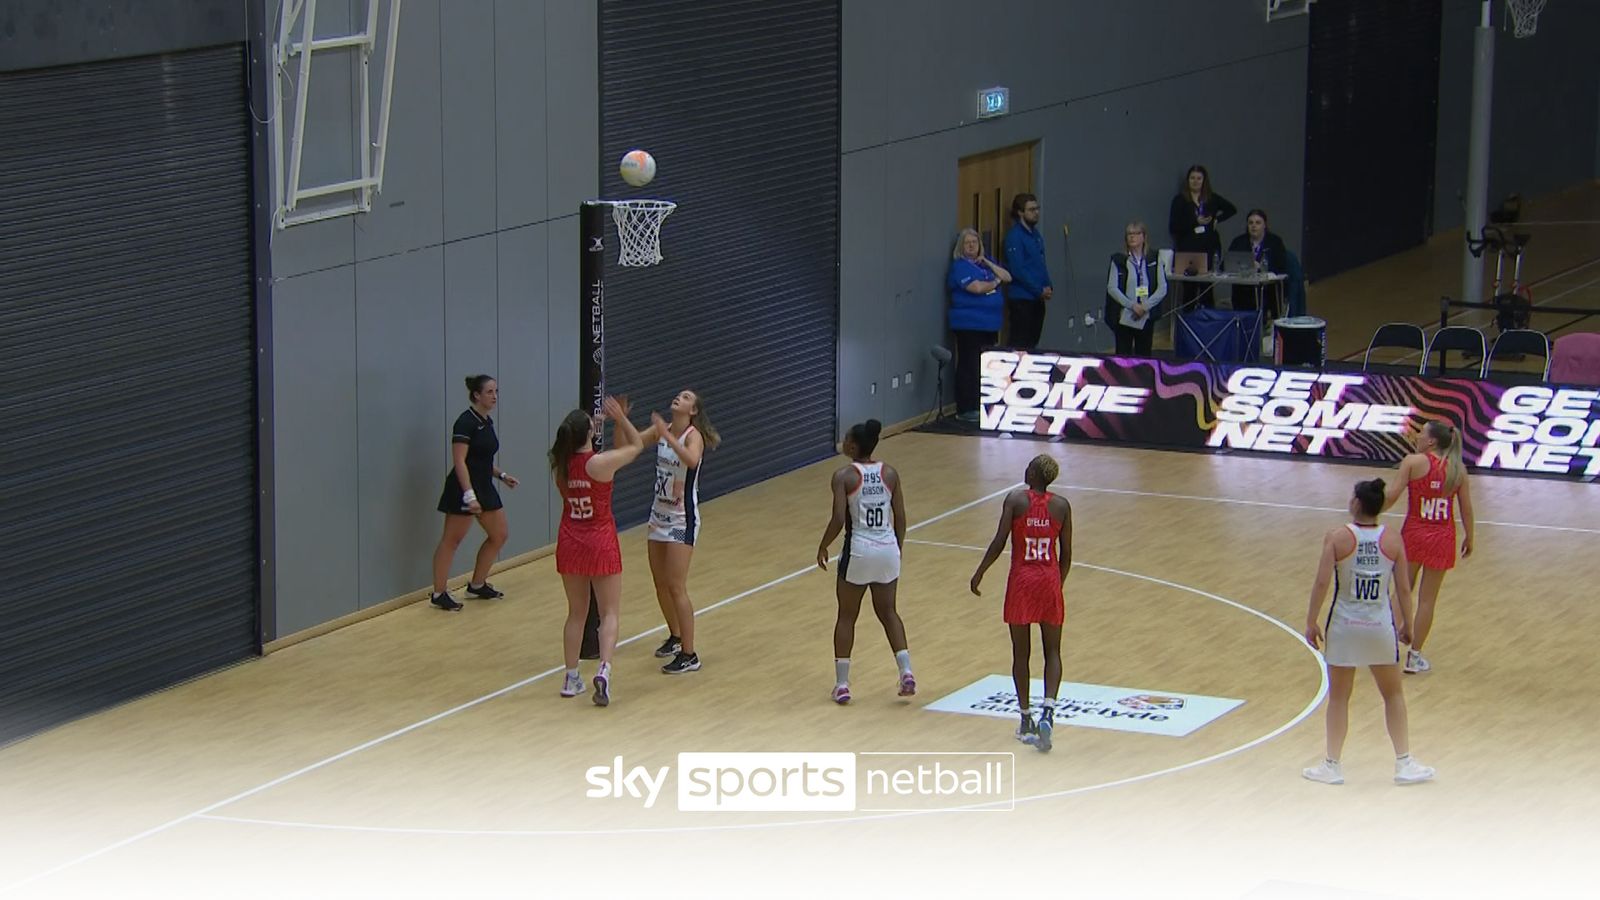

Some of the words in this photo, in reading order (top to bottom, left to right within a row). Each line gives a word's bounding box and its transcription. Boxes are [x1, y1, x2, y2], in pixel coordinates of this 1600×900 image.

[592, 280, 601, 344] NETBALL
[981, 351, 1103, 384] GET
[1227, 367, 1365, 401] GET
[1216, 395, 1412, 433] SOME
[1499, 385, 1600, 419] GE
[1205, 422, 1345, 455] NET
[863, 472, 882, 484] #95
[866, 507, 883, 527] GD
[1025, 537, 1050, 561] GA
[1356, 556, 1380, 565] MEYER
[1358, 541, 1378, 555] #105
[1355, 578, 1380, 600] WD
